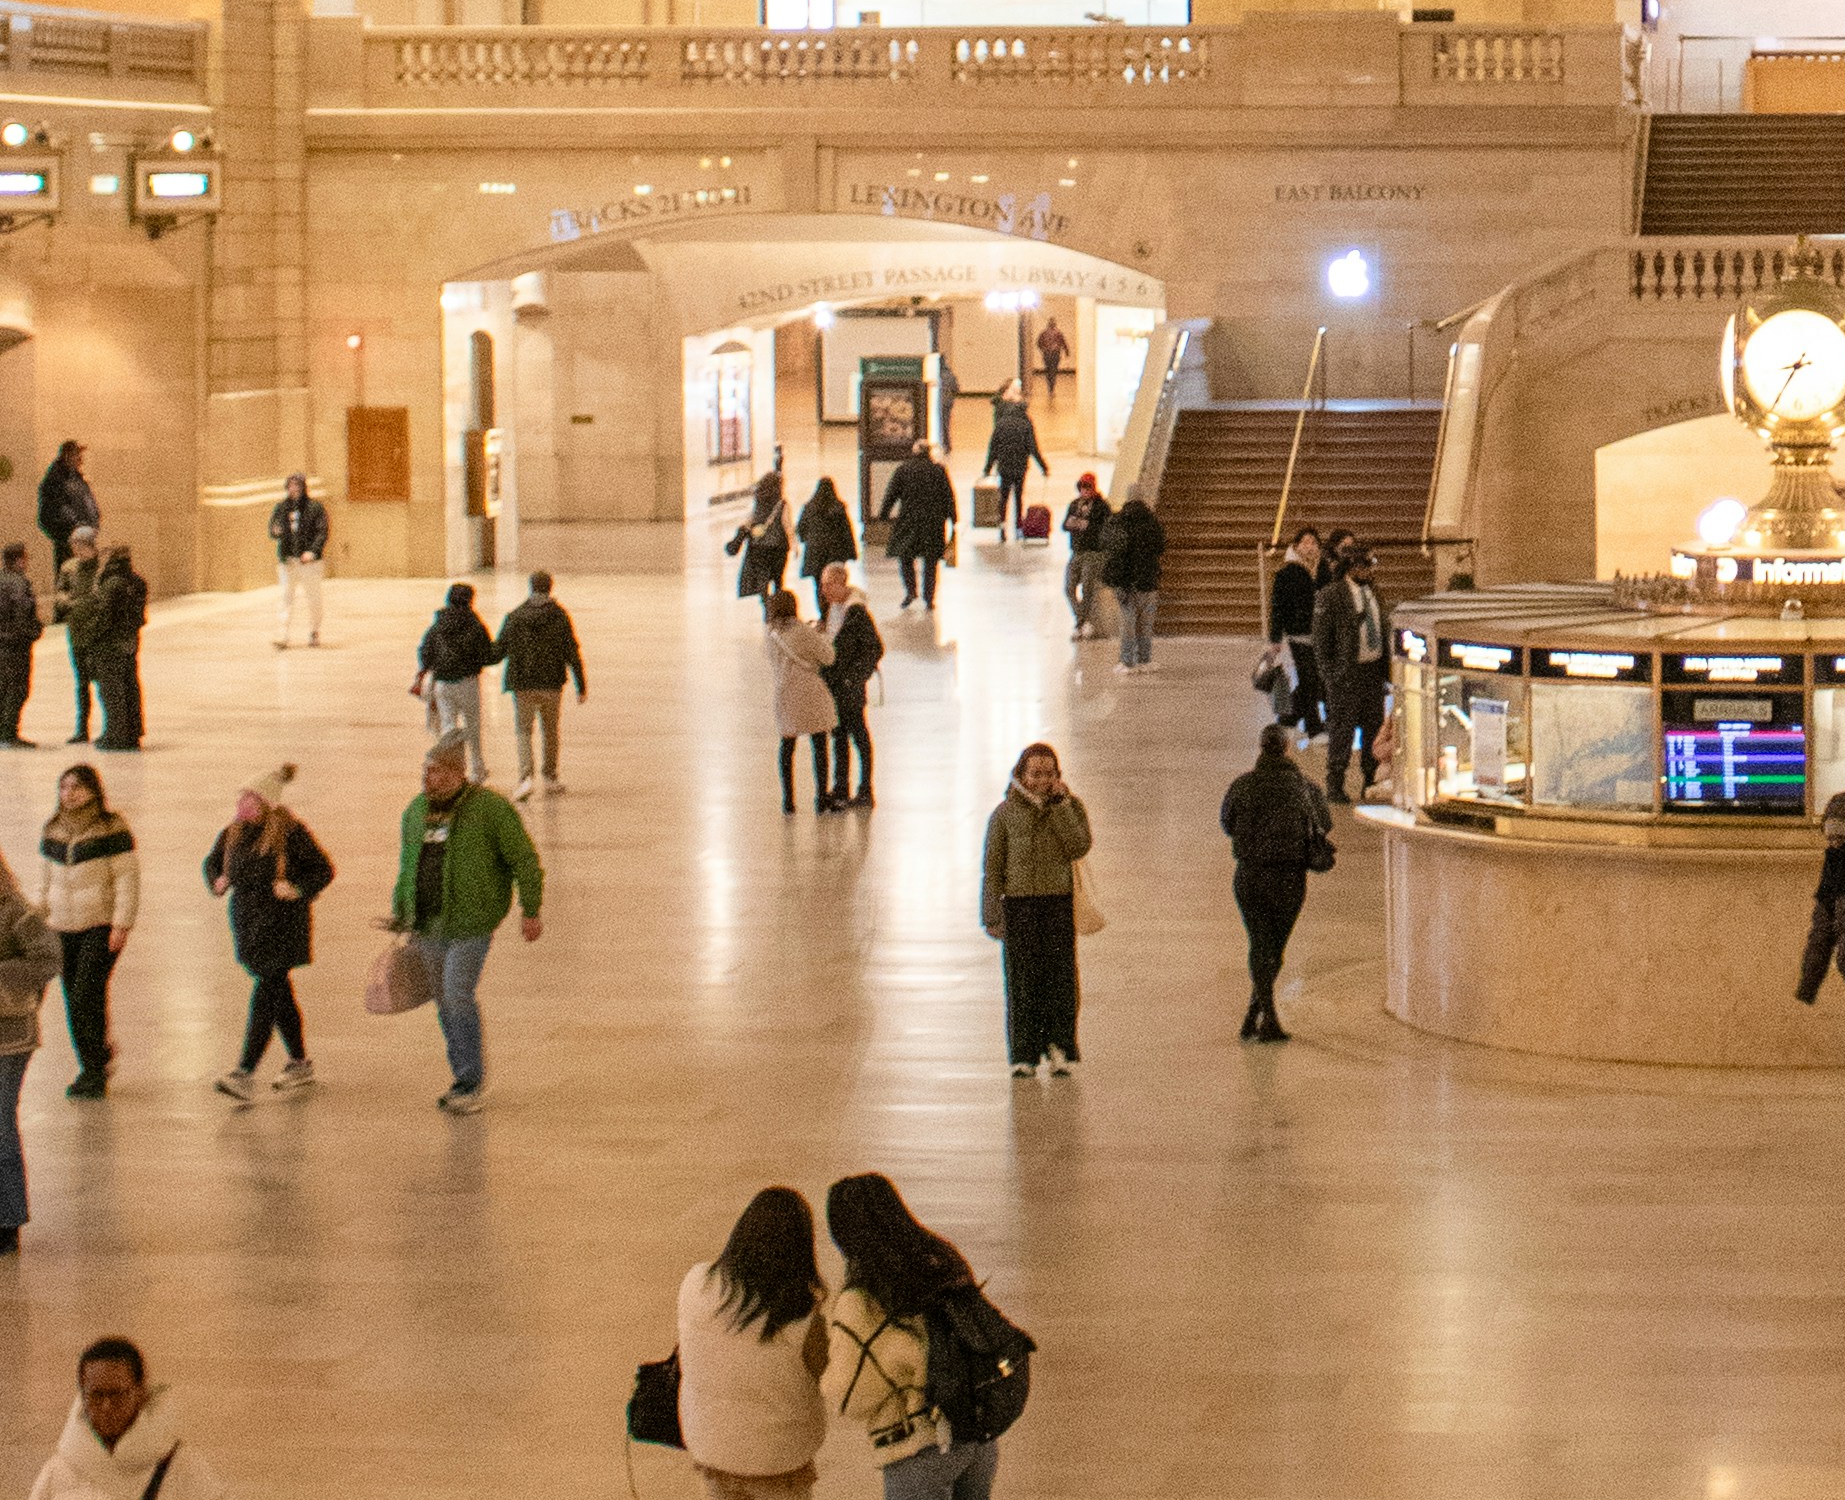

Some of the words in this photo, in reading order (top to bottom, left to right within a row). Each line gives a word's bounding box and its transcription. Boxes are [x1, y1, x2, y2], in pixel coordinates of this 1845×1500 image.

[850, 184, 1014, 223] LEXINGTON
[1018, 208, 1071, 233] AVE
[1274, 184, 1325, 202] EAST
[1330, 183, 1426, 201] BALCONY
[552, 198, 651, 233] TRACKS
[738, 283, 793, 309] 42ND
[798, 271, 876, 297] STREET
[883, 265, 977, 286] PASSAGE
[999, 265, 1091, 288] SUBWAY
[1096, 275, 1107, 290] 4
